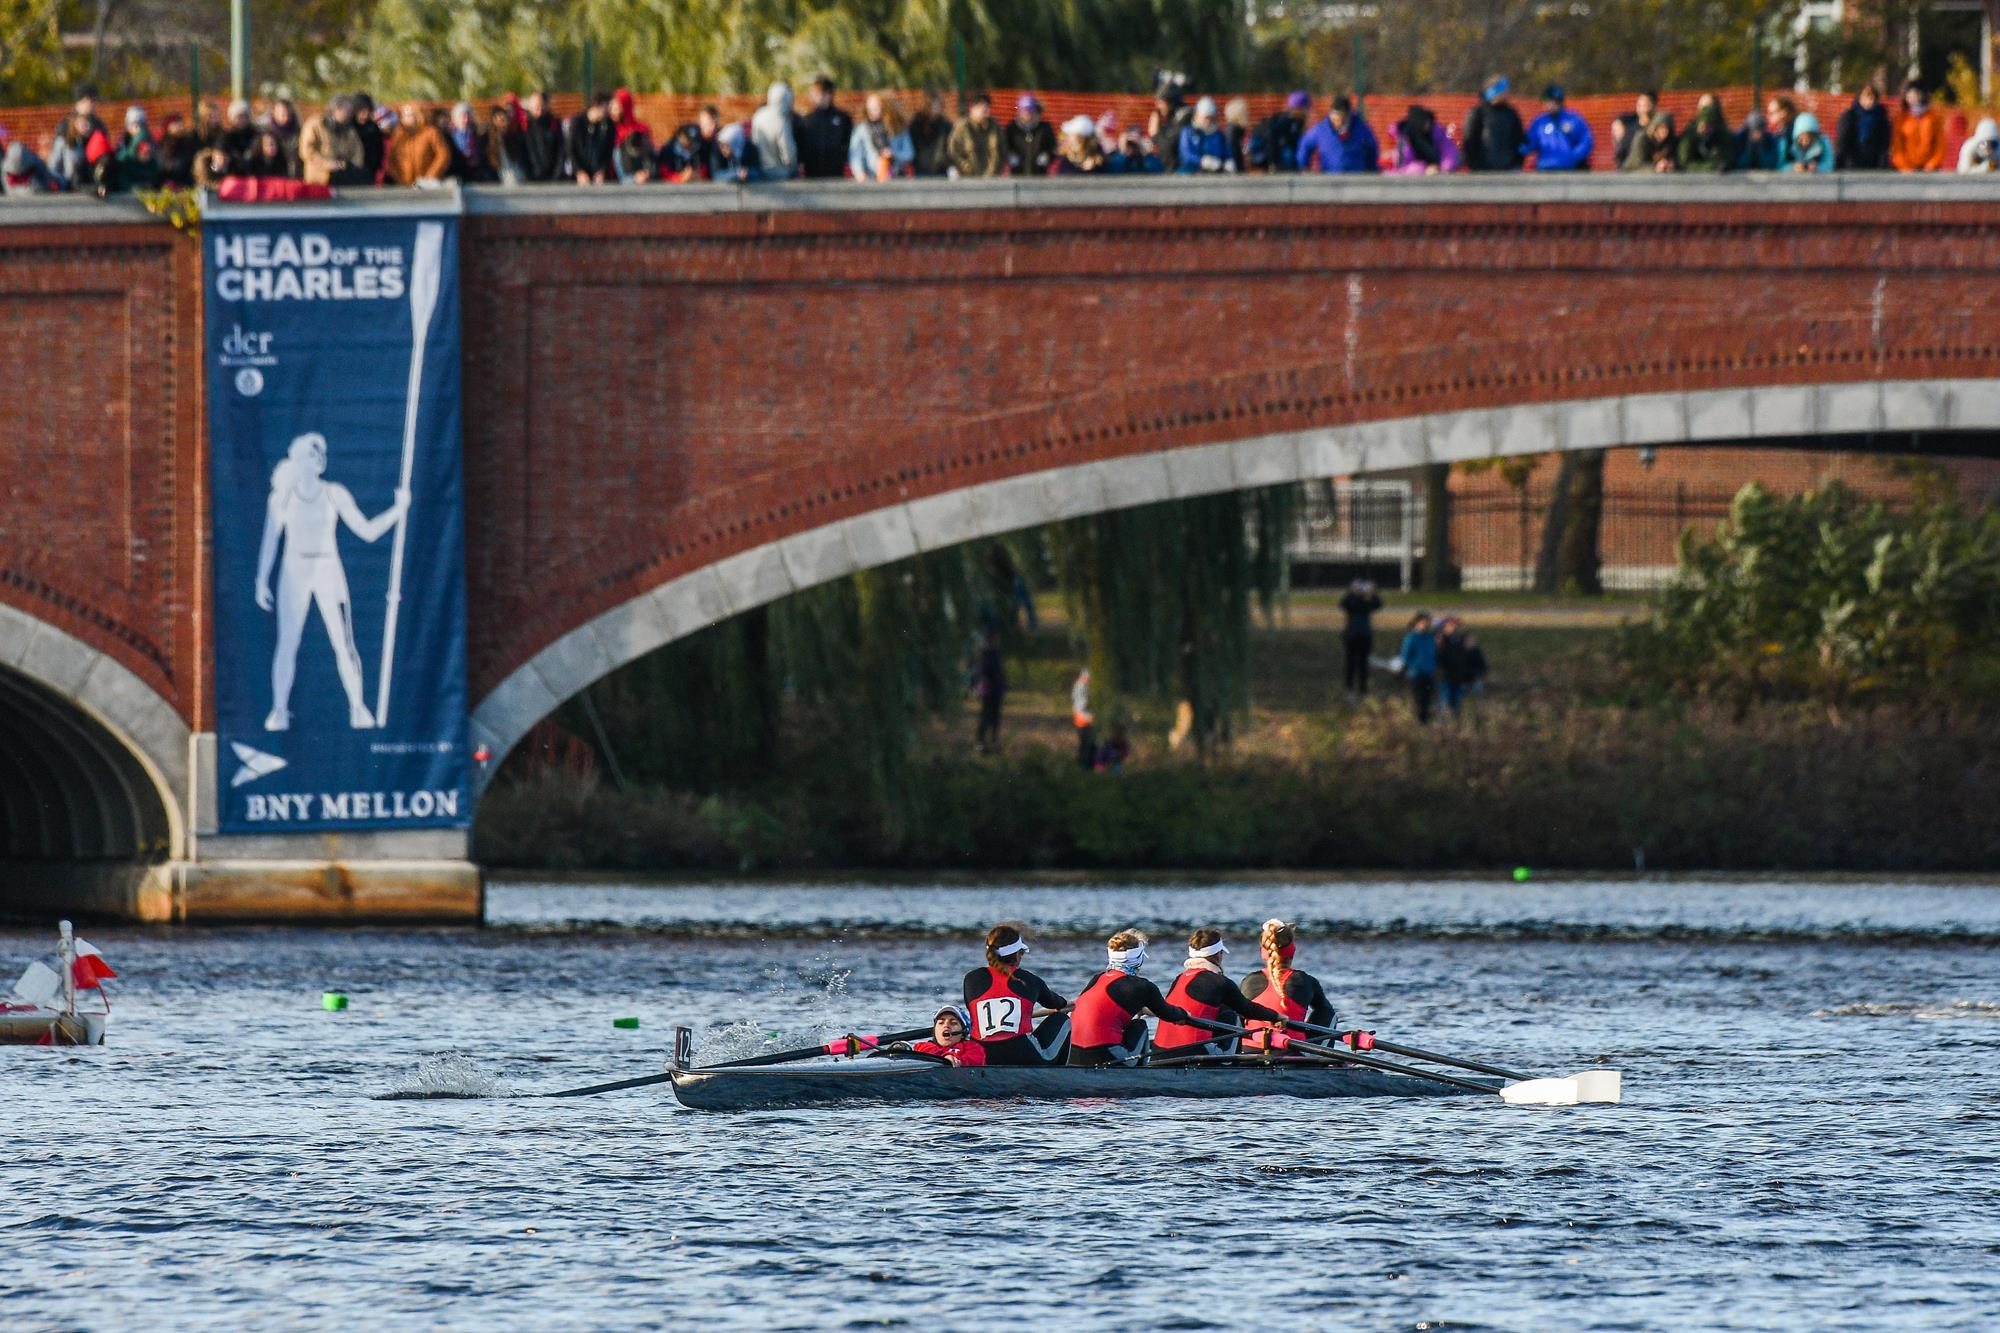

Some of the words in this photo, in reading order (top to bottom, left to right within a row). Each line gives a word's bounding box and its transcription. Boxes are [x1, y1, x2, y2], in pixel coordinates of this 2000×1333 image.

[215, 233, 330, 267] HEAD
[331, 248, 358, 265] OF
[364, 247, 402, 265] THE
[216, 268, 405, 301] CHARLES
[222, 323, 273, 355] dcr
[246, 794, 312, 820] BNY
[322, 789, 458, 819] MELLON
[983, 999, 1014, 1031] 12
[679, 1031, 690, 1062] 12
